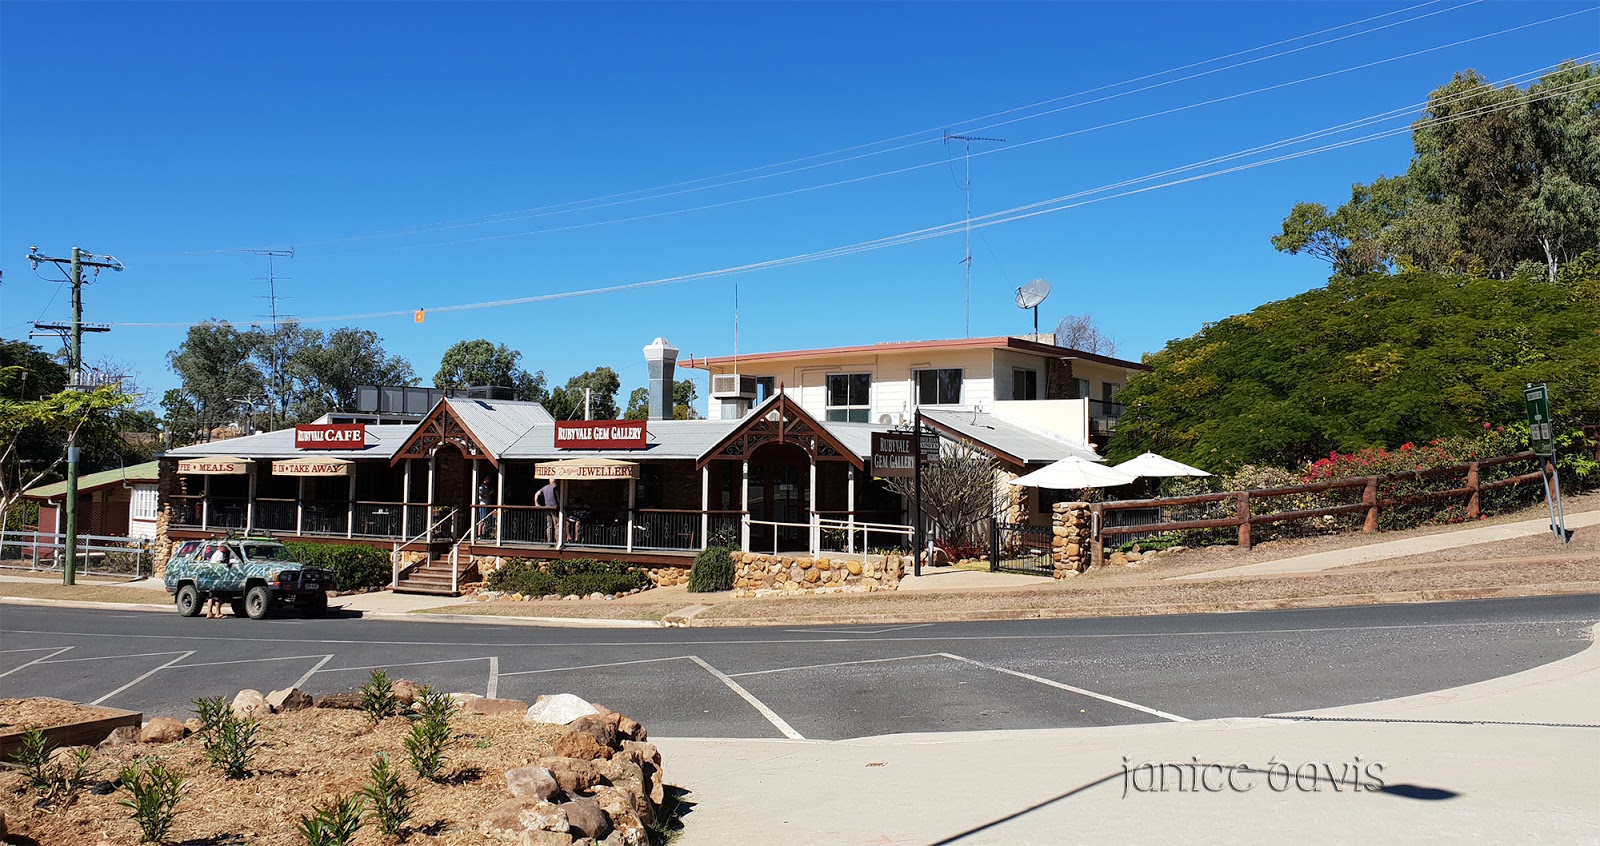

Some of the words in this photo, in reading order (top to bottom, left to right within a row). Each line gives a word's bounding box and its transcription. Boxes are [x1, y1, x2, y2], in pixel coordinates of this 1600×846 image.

[297, 430, 324, 442] RUBYVALE
[324, 429, 361, 441] CAFE
[557, 427, 592, 440] RUBYVALE
[593, 427, 609, 440] GEM
[611, 427, 642, 440] GALLERY
[880, 437, 910, 453] RUBYVALE
[199, 463, 234, 472] MEALS
[874, 453, 888, 469] GEM
[890, 454, 915, 469] GALLERY
[278, 464, 285, 473] IN
[289, 464, 310, 473] TAKE
[311, 464, 339, 473] AWAY
[577, 466, 633, 477] JEWELLERY
